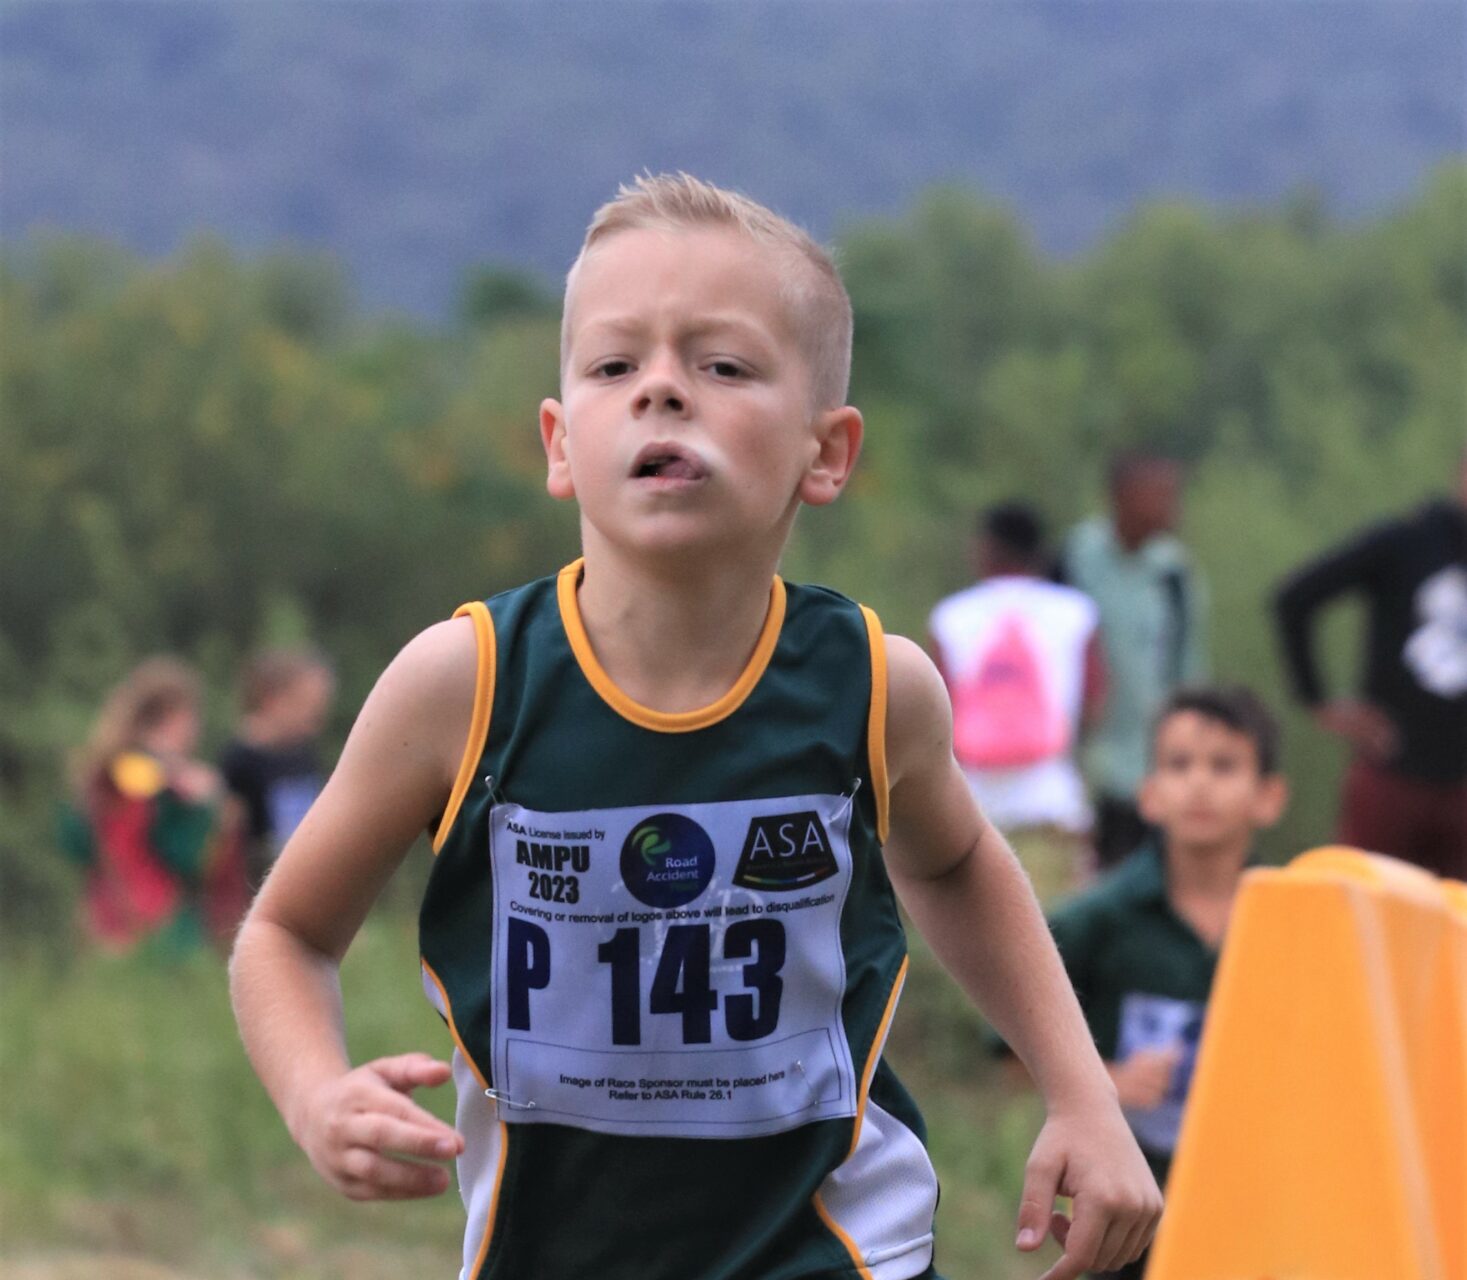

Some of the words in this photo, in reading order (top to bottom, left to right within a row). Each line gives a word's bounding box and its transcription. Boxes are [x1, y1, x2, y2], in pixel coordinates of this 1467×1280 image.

[507, 822, 528, 836] ASA
[563, 828, 593, 840] issued
[594, 828, 606, 841] by
[749, 820, 826, 860] ASA
[516, 839, 590, 873] AMPU
[665, 855, 699, 868] Road
[528, 871, 580, 904] 2023
[646, 869, 700, 882] Accident
[510, 900, 552, 921] Covering
[554, 912, 566, 921] or
[568, 912, 615, 923] removal
[617, 911, 630, 923] of
[631, 911, 663, 924] logos
[665, 908, 701, 920] above
[704, 906, 722, 918] will
[725, 903, 750, 915] lead
[752, 903, 764, 914] to
[766, 893, 835, 914] disqualification
[507, 916, 551, 1031] P
[598, 918, 787, 1046] 143
[560, 1073, 592, 1088] Image
[594, 1077, 606, 1088] of
[607, 1078, 636, 1089] Race
[638, 1078, 684, 1090] Sponsor
[686, 1078, 714, 1088] must
[716, 1077, 731, 1088] be
[732, 1074, 767, 1089] placed
[608, 1089, 639, 1100] Refer
[641, 1090, 653, 1101] to
[654, 1089, 680, 1100] ASA
[681, 1089, 707, 1100] Rule
[708, 1089, 733, 1101] 26.1
